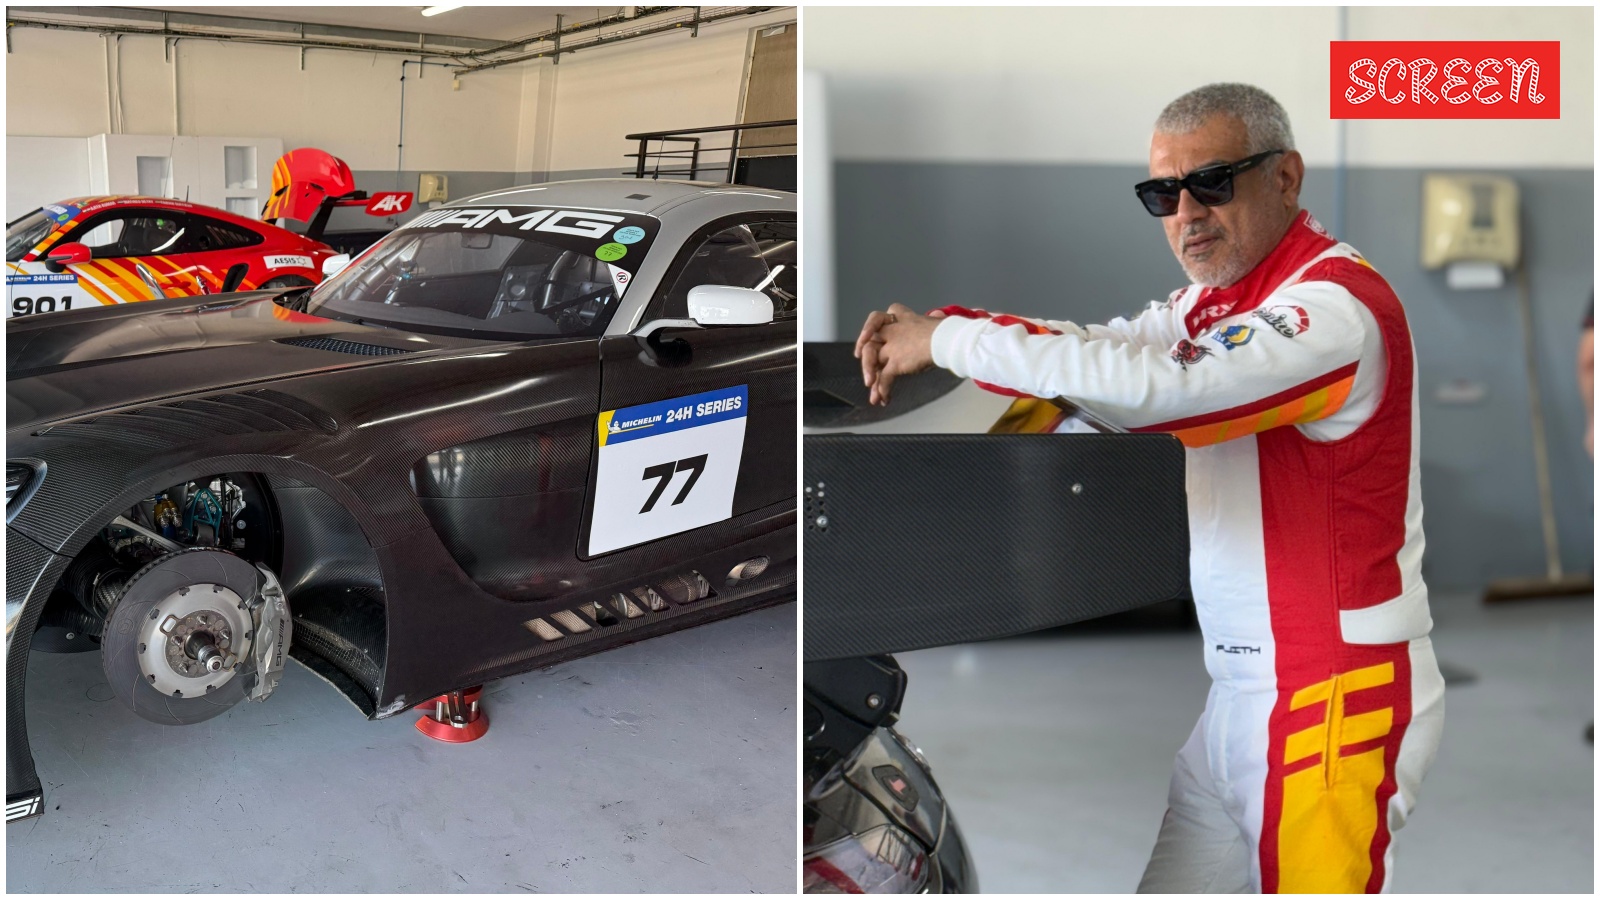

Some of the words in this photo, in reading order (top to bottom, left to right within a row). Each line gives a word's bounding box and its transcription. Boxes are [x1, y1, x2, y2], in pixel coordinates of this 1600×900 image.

[371, 195, 407, 211] AK
[426, 209, 625, 239] AMG
[274, 257, 297, 265] AESIS
[13, 295, 72, 317] 901
[621, 414, 662, 429] MICHELIN
[665, 405, 693, 424] 24H
[695, 396, 742, 417] SERIES
[638, 453, 709, 515] 77
[276, 632, 284, 667] AMG
